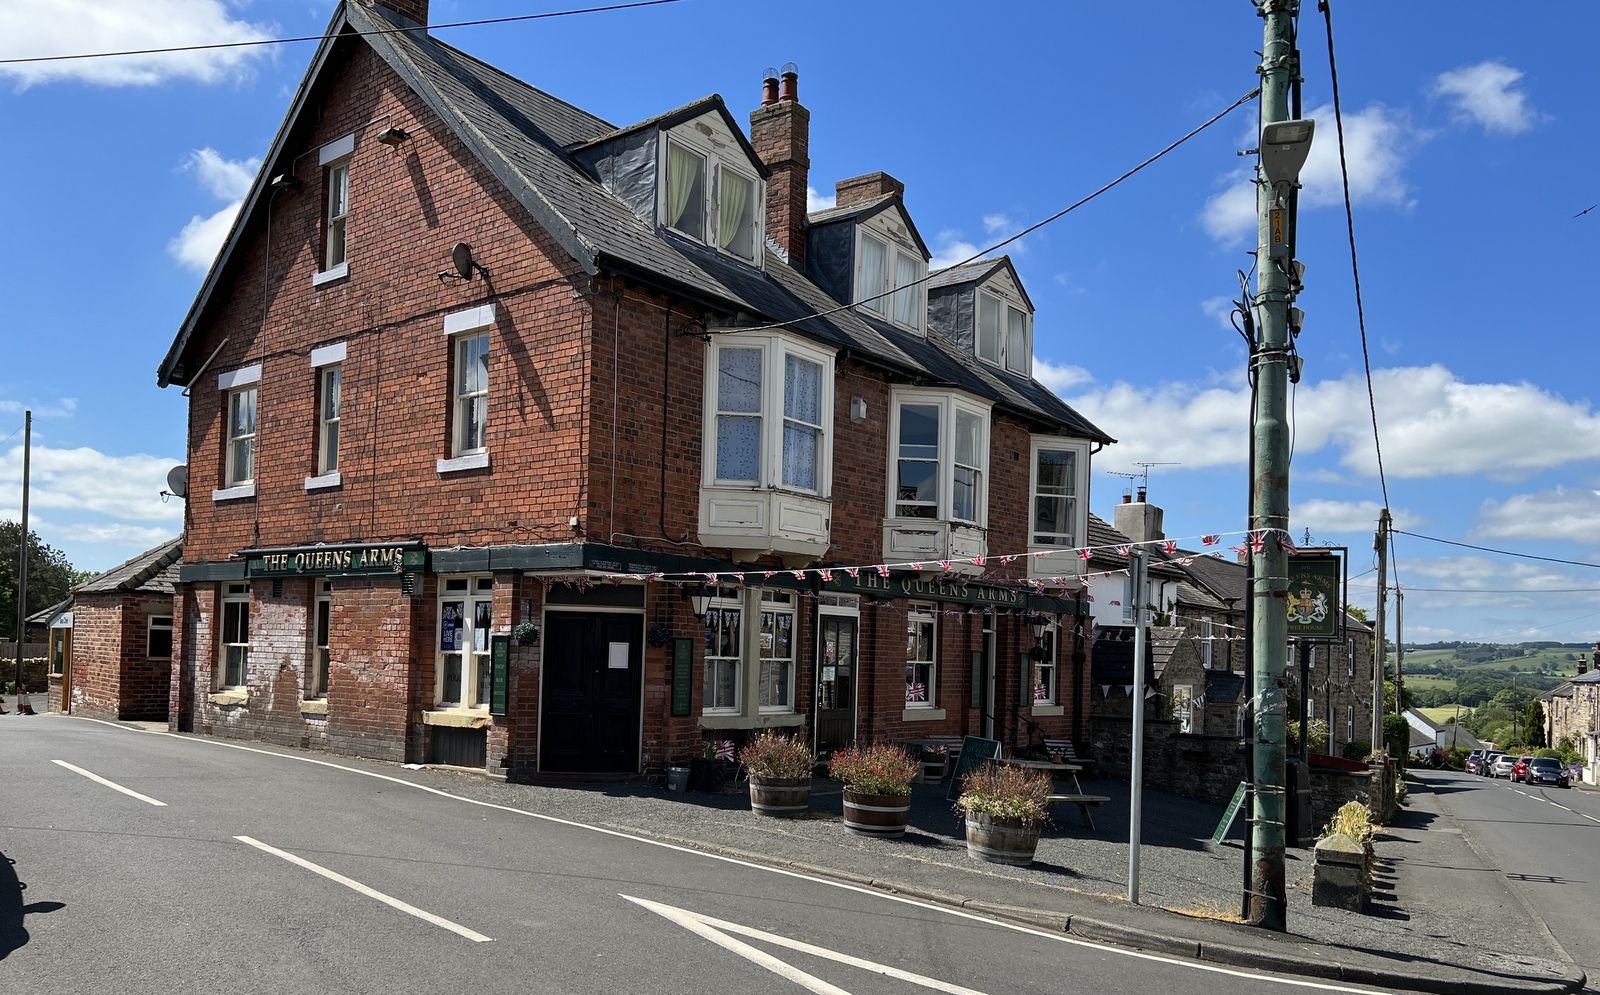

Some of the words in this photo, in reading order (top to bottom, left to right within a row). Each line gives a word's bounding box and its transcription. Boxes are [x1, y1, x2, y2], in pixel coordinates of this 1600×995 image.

[262, 554, 289, 572] THE
[295, 550, 352, 573] QUEENS
[359, 547, 404, 569] ARMS
[854, 571, 890, 590] THE
[901, 577, 968, 598] QUEENS
[977, 585, 1017, 603] ARMS
